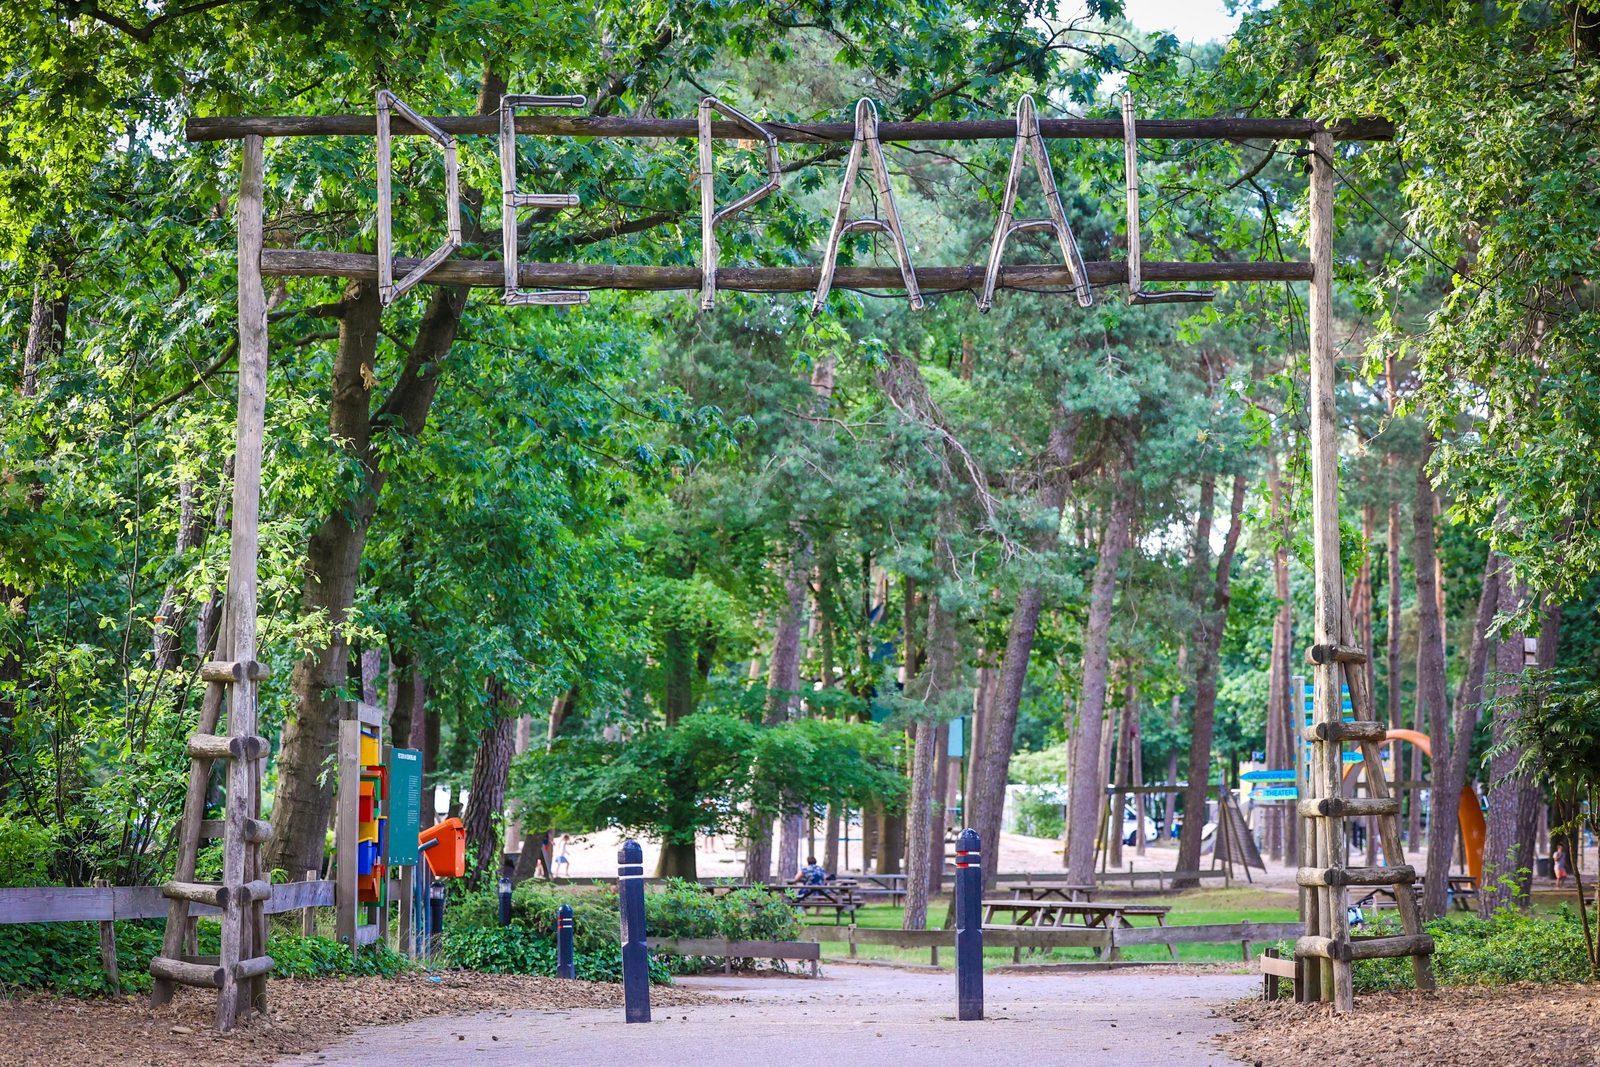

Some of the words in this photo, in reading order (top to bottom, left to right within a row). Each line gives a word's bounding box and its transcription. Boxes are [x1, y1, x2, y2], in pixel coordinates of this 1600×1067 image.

[377, 89, 589, 307] DE
[699, 91, 1215, 314] PAAL
[1265, 789, 1294, 797] THEATER
